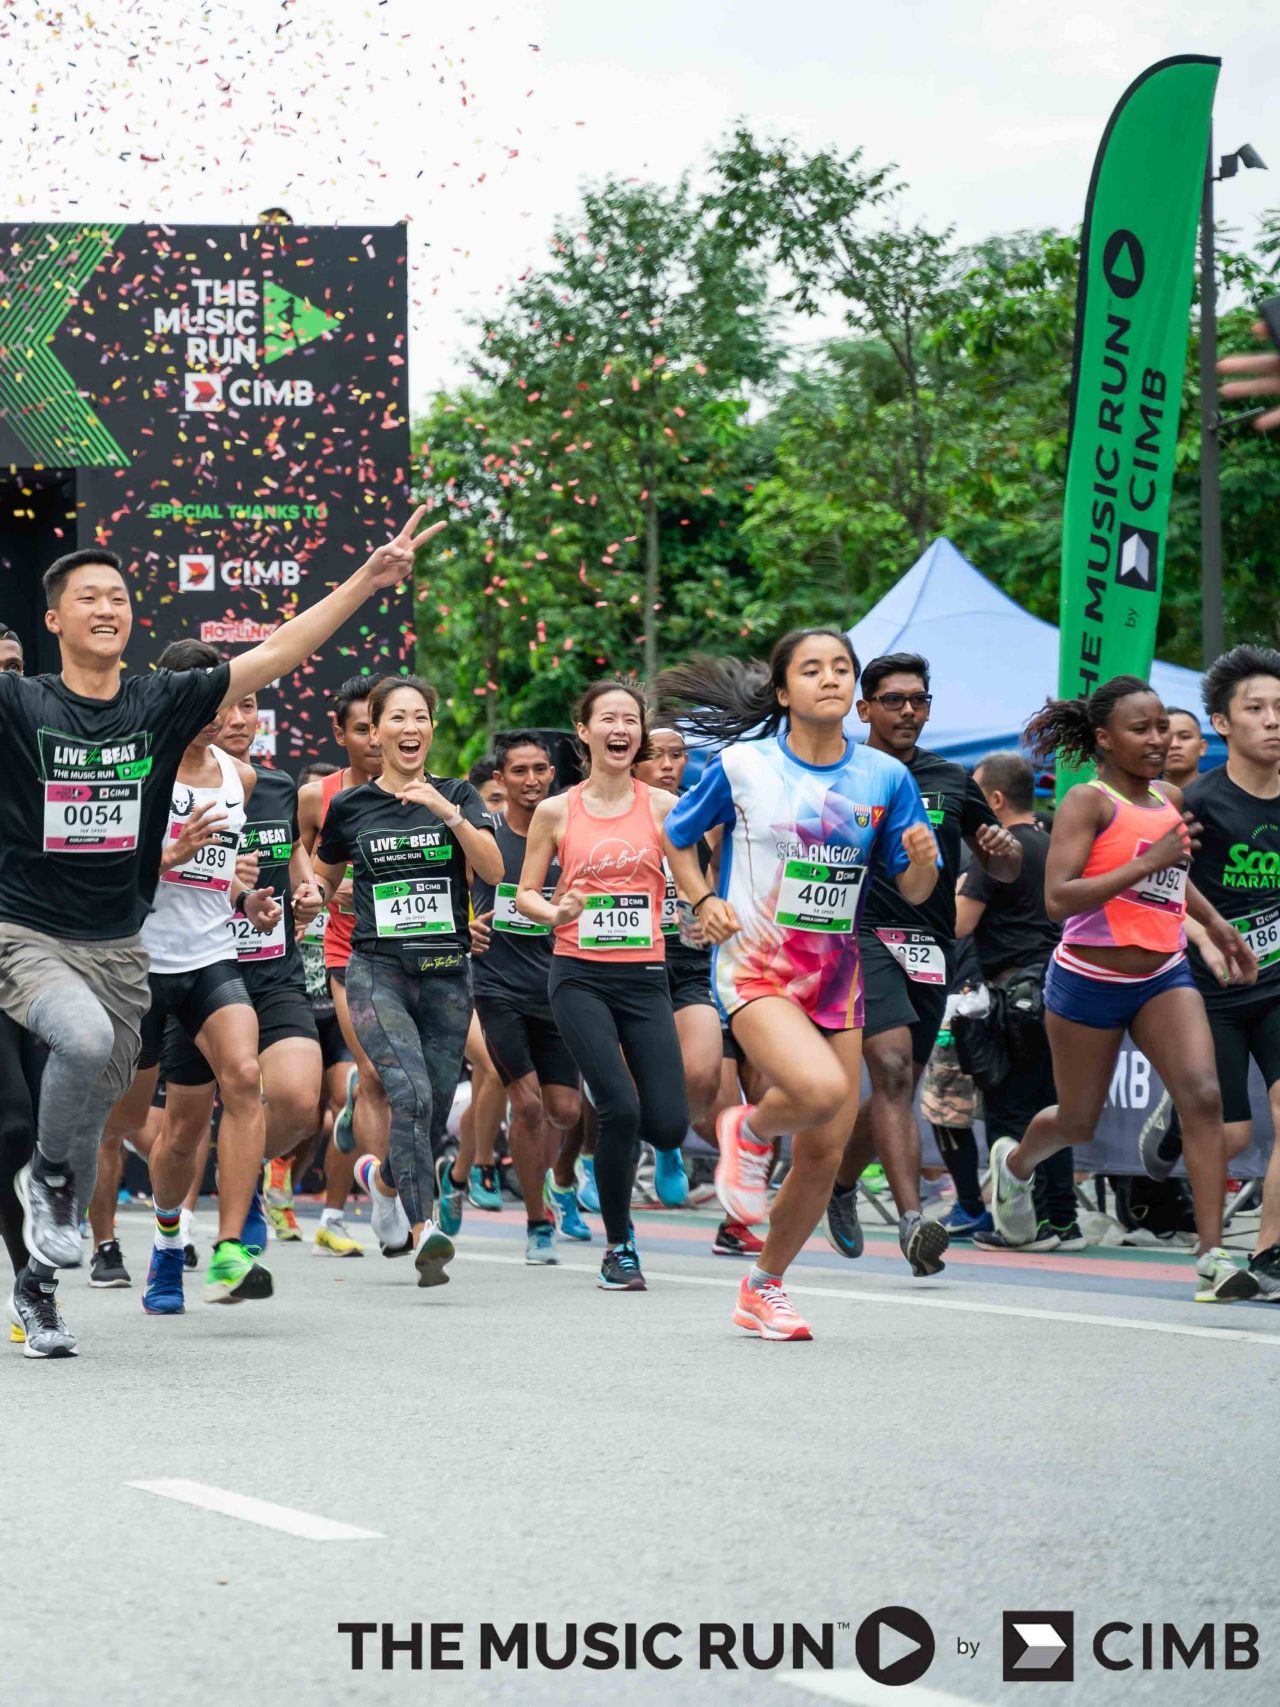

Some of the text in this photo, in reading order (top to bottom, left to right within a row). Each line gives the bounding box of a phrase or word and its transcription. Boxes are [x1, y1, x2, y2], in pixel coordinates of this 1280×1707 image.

[191, 279, 259, 306] THE
[154, 308, 257, 335] MUSIC
[186, 338, 256, 365] RUN
[229, 379, 313, 406] CIMB
[1078, 313, 1131, 700] HE MUSIC RUN
[1125, 367, 1166, 628] by CIMB
[148, 504, 223, 519] SPECIAL
[228, 505, 300, 520] THANKS
[220, 560, 301, 585] CIMB
[54, 746, 87, 766] LIVE
[101, 743, 136, 765] BEAT
[53, 769, 115, 779] THE MUSIC RUN
[110, 788, 129, 797] CIMB
[64, 804, 123, 825] 0054
[258, 829, 287, 845] BEAT
[370, 837, 397, 852] LIVE
[410, 833, 440, 848] BEAT
[194, 847, 227, 868] 089
[386, 854, 406, 862] MUSIC
[776, 842, 860, 863] SELANGOR
[390, 896, 438, 916] 4104
[798, 884, 847, 908] 4001
[593, 911, 639, 927] 4106
[1244, 925, 1278, 951] 186
